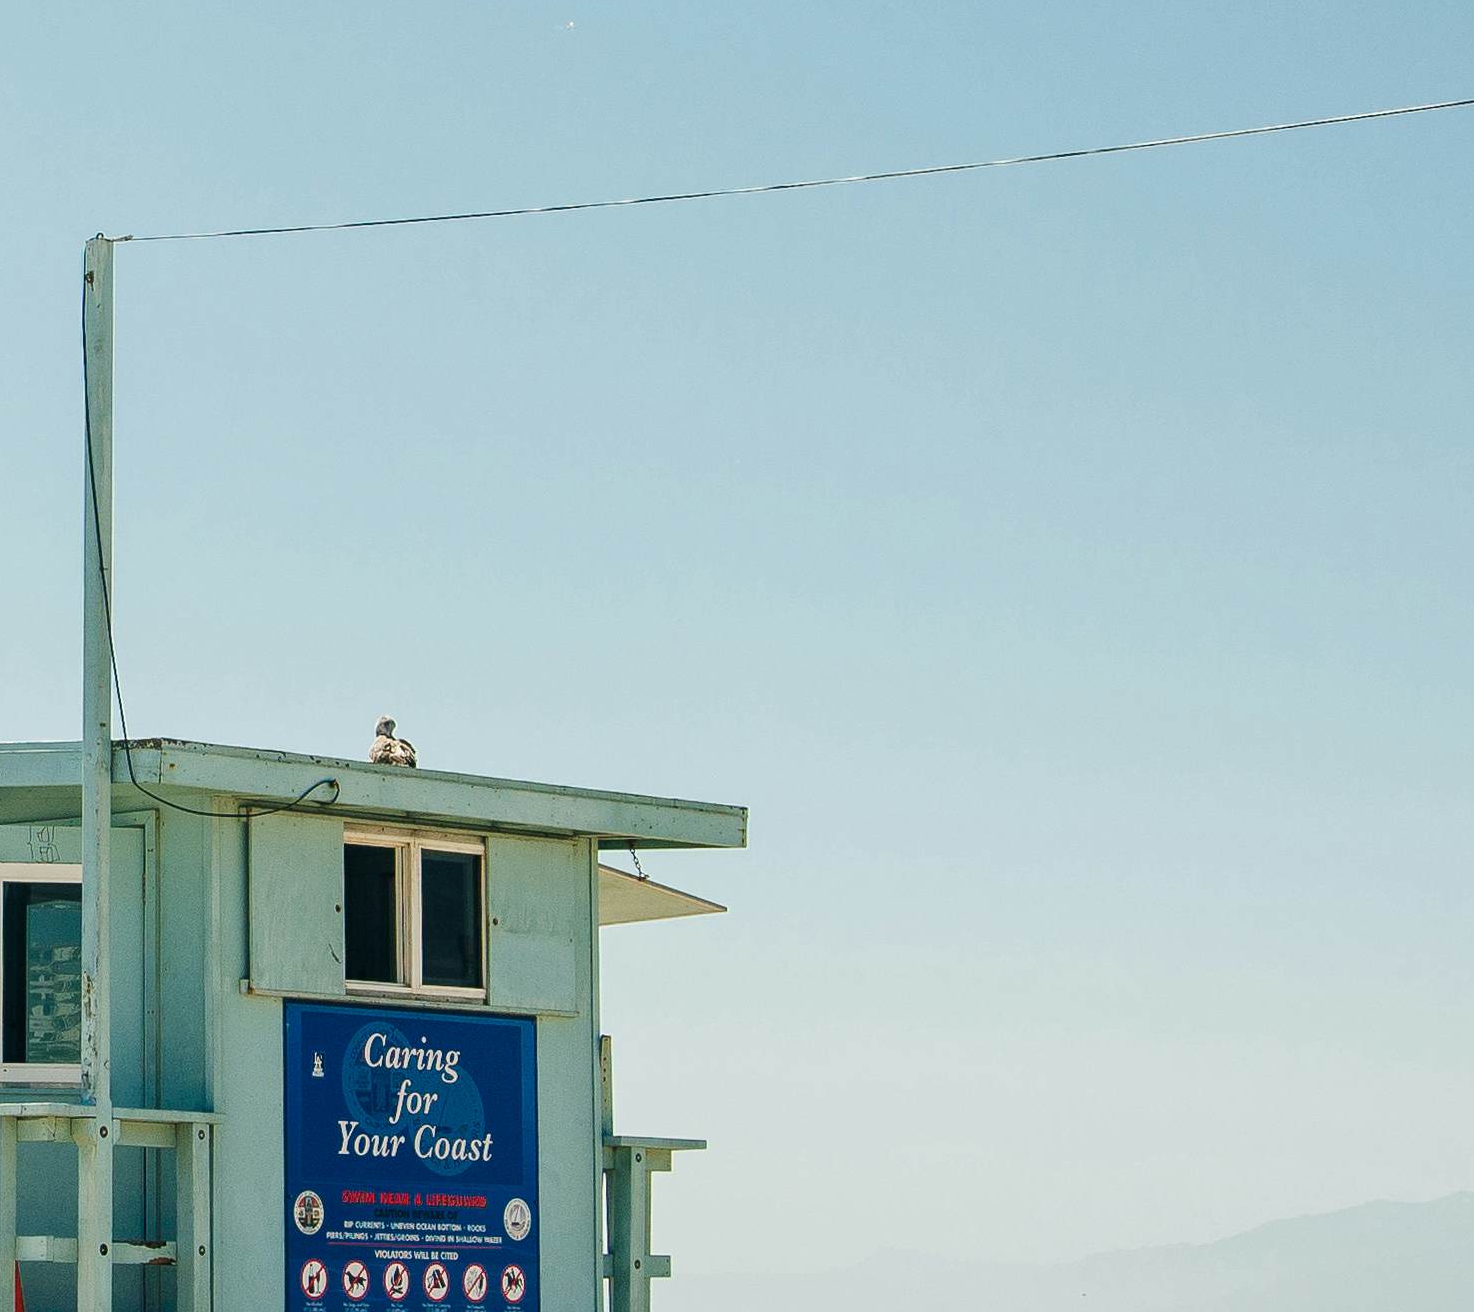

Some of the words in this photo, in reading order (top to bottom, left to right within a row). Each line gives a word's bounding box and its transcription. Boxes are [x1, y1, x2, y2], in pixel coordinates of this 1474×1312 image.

[364, 1032, 461, 1083] Caring
[389, 1079, 438, 1124] for
[337, 1120, 406, 1157] Your
[414, 1124, 493, 1162] Coast
[342, 1190, 375, 1203] SWIM
[380, 1192, 410, 1205] NEAR
[414, 1192, 423, 1206] A
[426, 1193, 487, 1208] LIFEGUARD
[374, 1208, 410, 1218] CAUTION
[344, 1220, 354, 1229] RIP
[355, 1221, 385, 1229] CURRENTS
[390, 1222, 414, 1230] UNEVEN
[415, 1222, 436, 1231] OCEAN
[437, 1223, 462, 1232] BOTTOM
[467, 1224, 486, 1232] ROCKS
[425, 1234, 446, 1242] DIVING
[447, 1235, 455, 1243] IN
[456, 1235, 483, 1243] SHALLOW
[374, 1249, 412, 1259] VIOLATORS
[413, 1251, 429, 1260] WILL
[431, 1251, 439, 1260] BE
[440, 1251, 459, 1261] CITED
